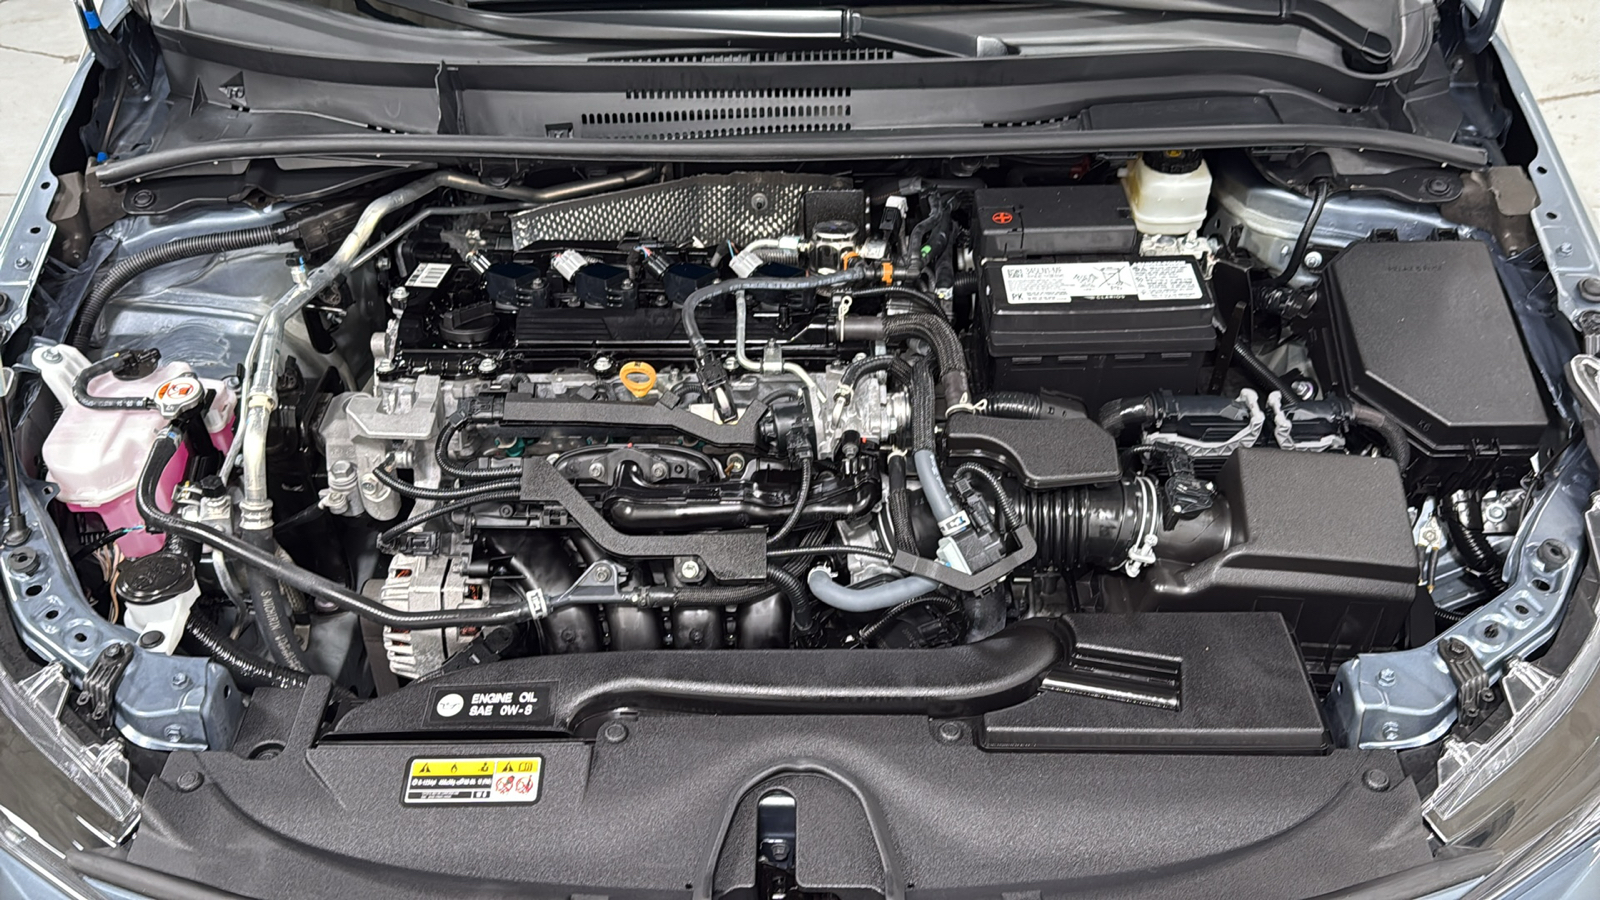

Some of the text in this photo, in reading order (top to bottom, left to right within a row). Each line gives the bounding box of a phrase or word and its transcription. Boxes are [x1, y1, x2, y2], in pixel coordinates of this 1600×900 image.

[471, 691, 538, 704] ENGINE OIL
[468, 704, 533, 716] SAE 0W-8
